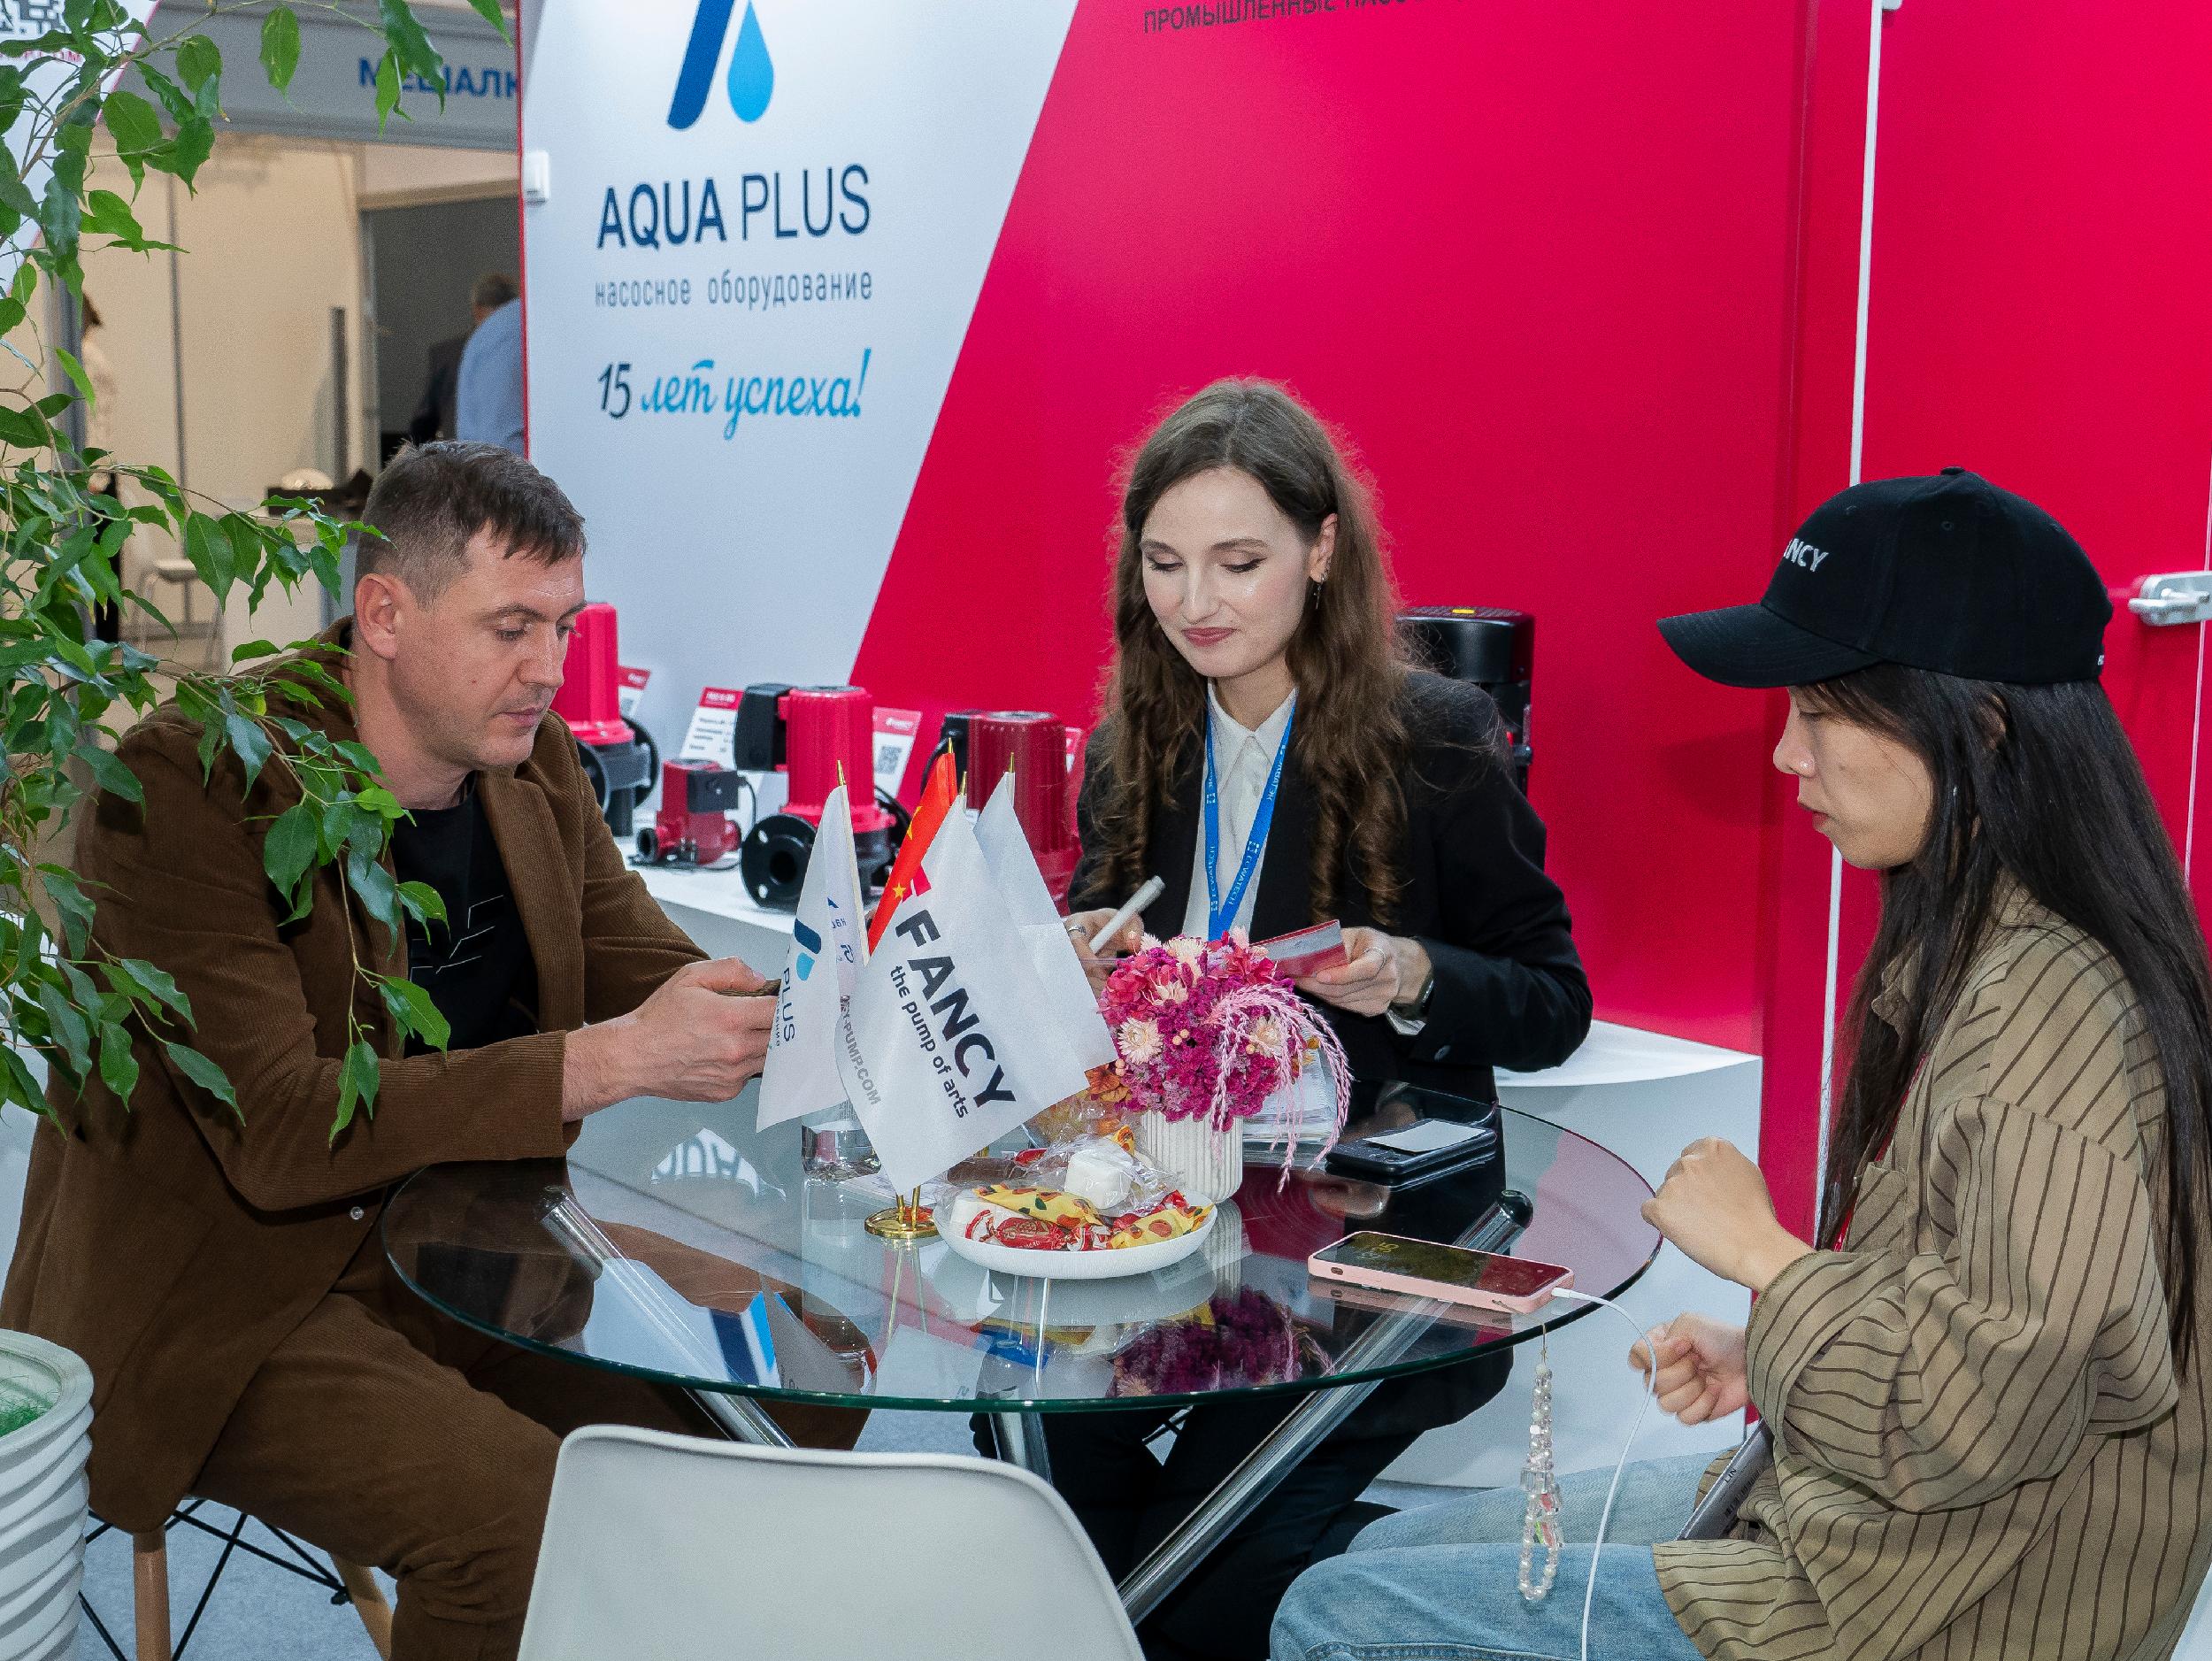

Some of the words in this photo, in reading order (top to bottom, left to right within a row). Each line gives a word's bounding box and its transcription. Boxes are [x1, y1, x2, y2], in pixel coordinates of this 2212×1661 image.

[596, 178, 727, 250] AQUA
[741, 164, 871, 242] PLUS
[595, 278, 691, 307] насосное
[707, 269, 872, 310] оборудование
[597, 361, 632, 420] 15
[641, 359, 718, 413] лет
[724, 346, 872, 440] успеха!
[1784, 538, 1829, 573] NCY
[782, 967, 795, 1042] PLUS
[890, 965, 910, 998] the
[902, 1002, 936, 1052] pump
[933, 1056, 952, 1074] of
[943, 1080, 969, 1118] arts
[895, 910, 1017, 1108] FANCY
